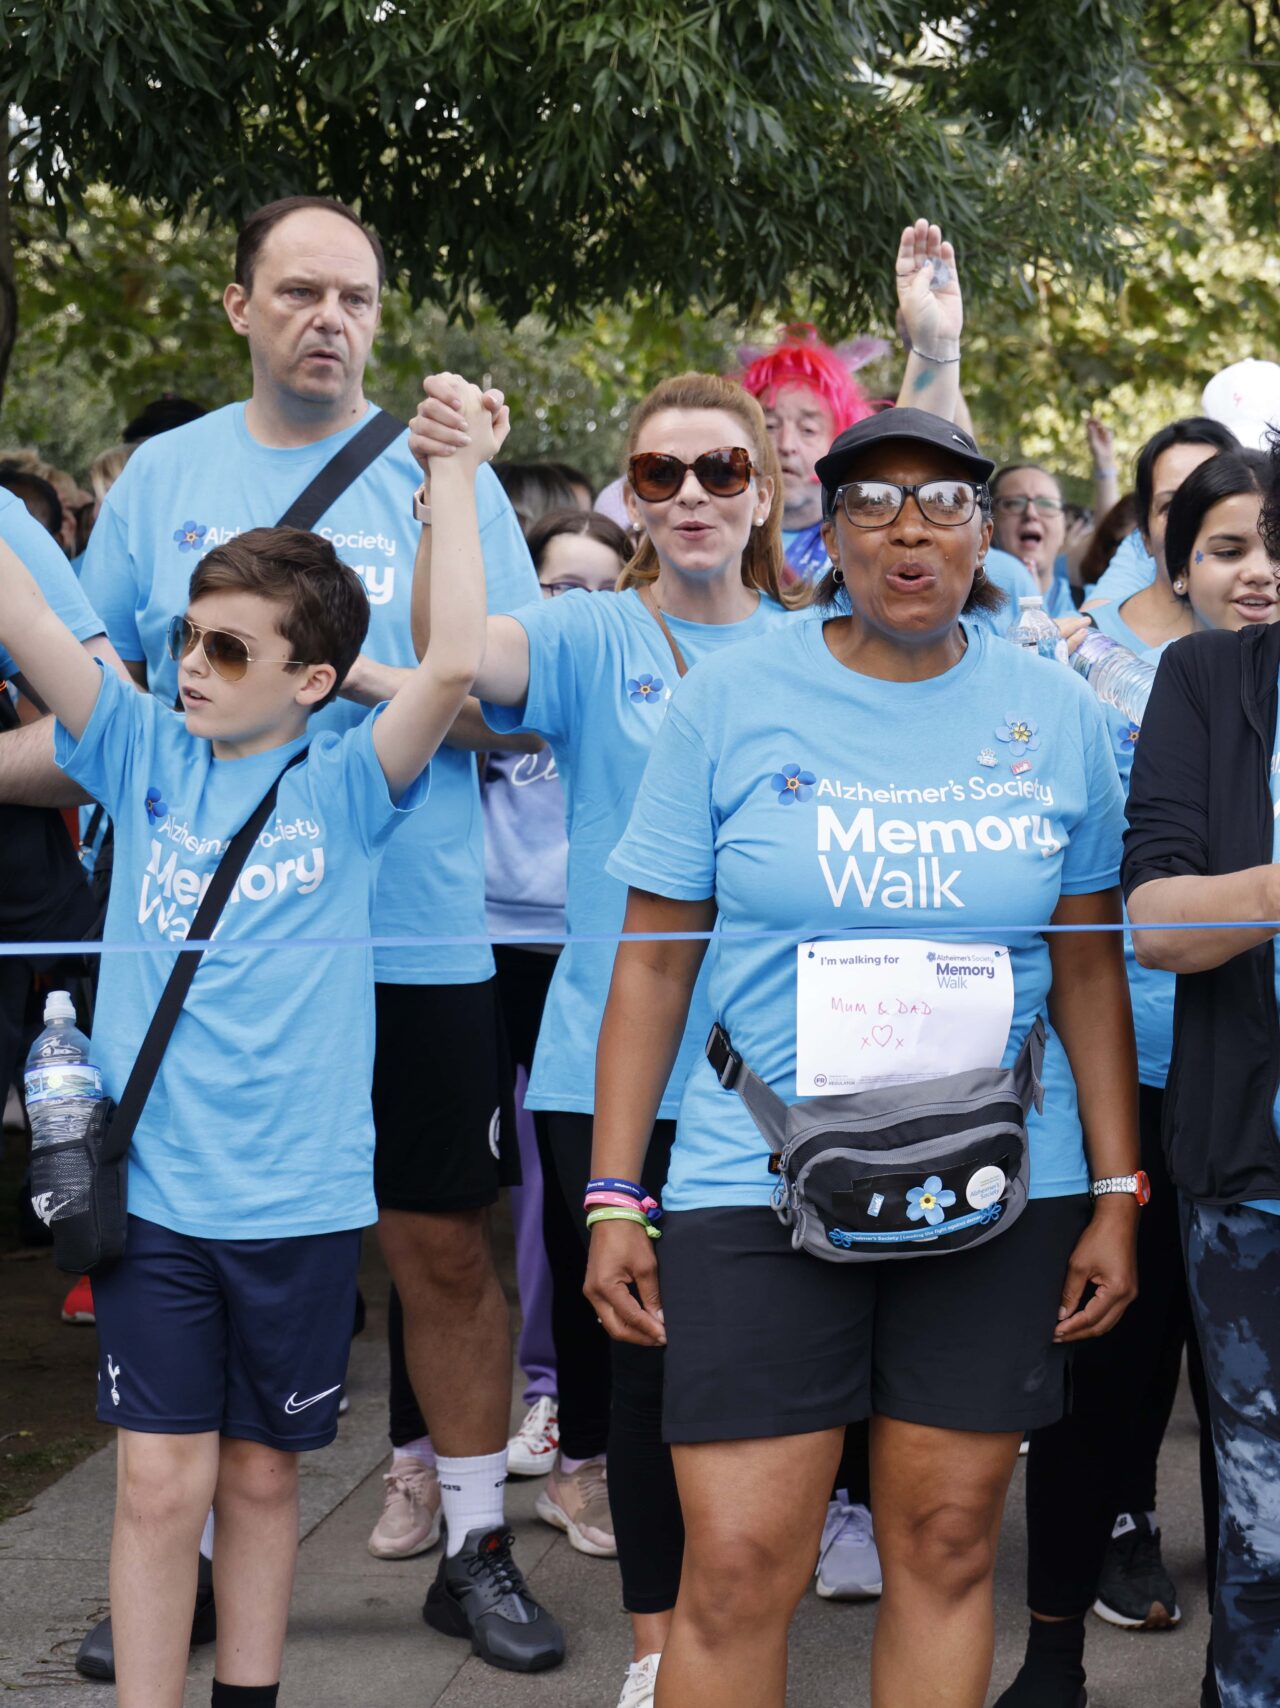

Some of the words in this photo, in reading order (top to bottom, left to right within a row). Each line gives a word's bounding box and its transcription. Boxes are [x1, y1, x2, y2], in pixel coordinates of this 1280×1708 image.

[319, 527, 396, 557] Society
[817, 778, 966, 805] Alzheimer's
[968, 775, 1054, 806] Society
[816, 805, 1061, 858] Memory
[817, 855, 966, 910] Walk
[820, 956, 837, 966] I'm
[839, 955, 881, 966] walking
[883, 955, 900, 965] for
[936, 953, 971, 962] Alzheimer's
[971, 954, 995, 963] Society
[936, 962, 995, 979] Memory
[937, 976, 968, 989] Walk
[878, 1001, 890, 1015] &
